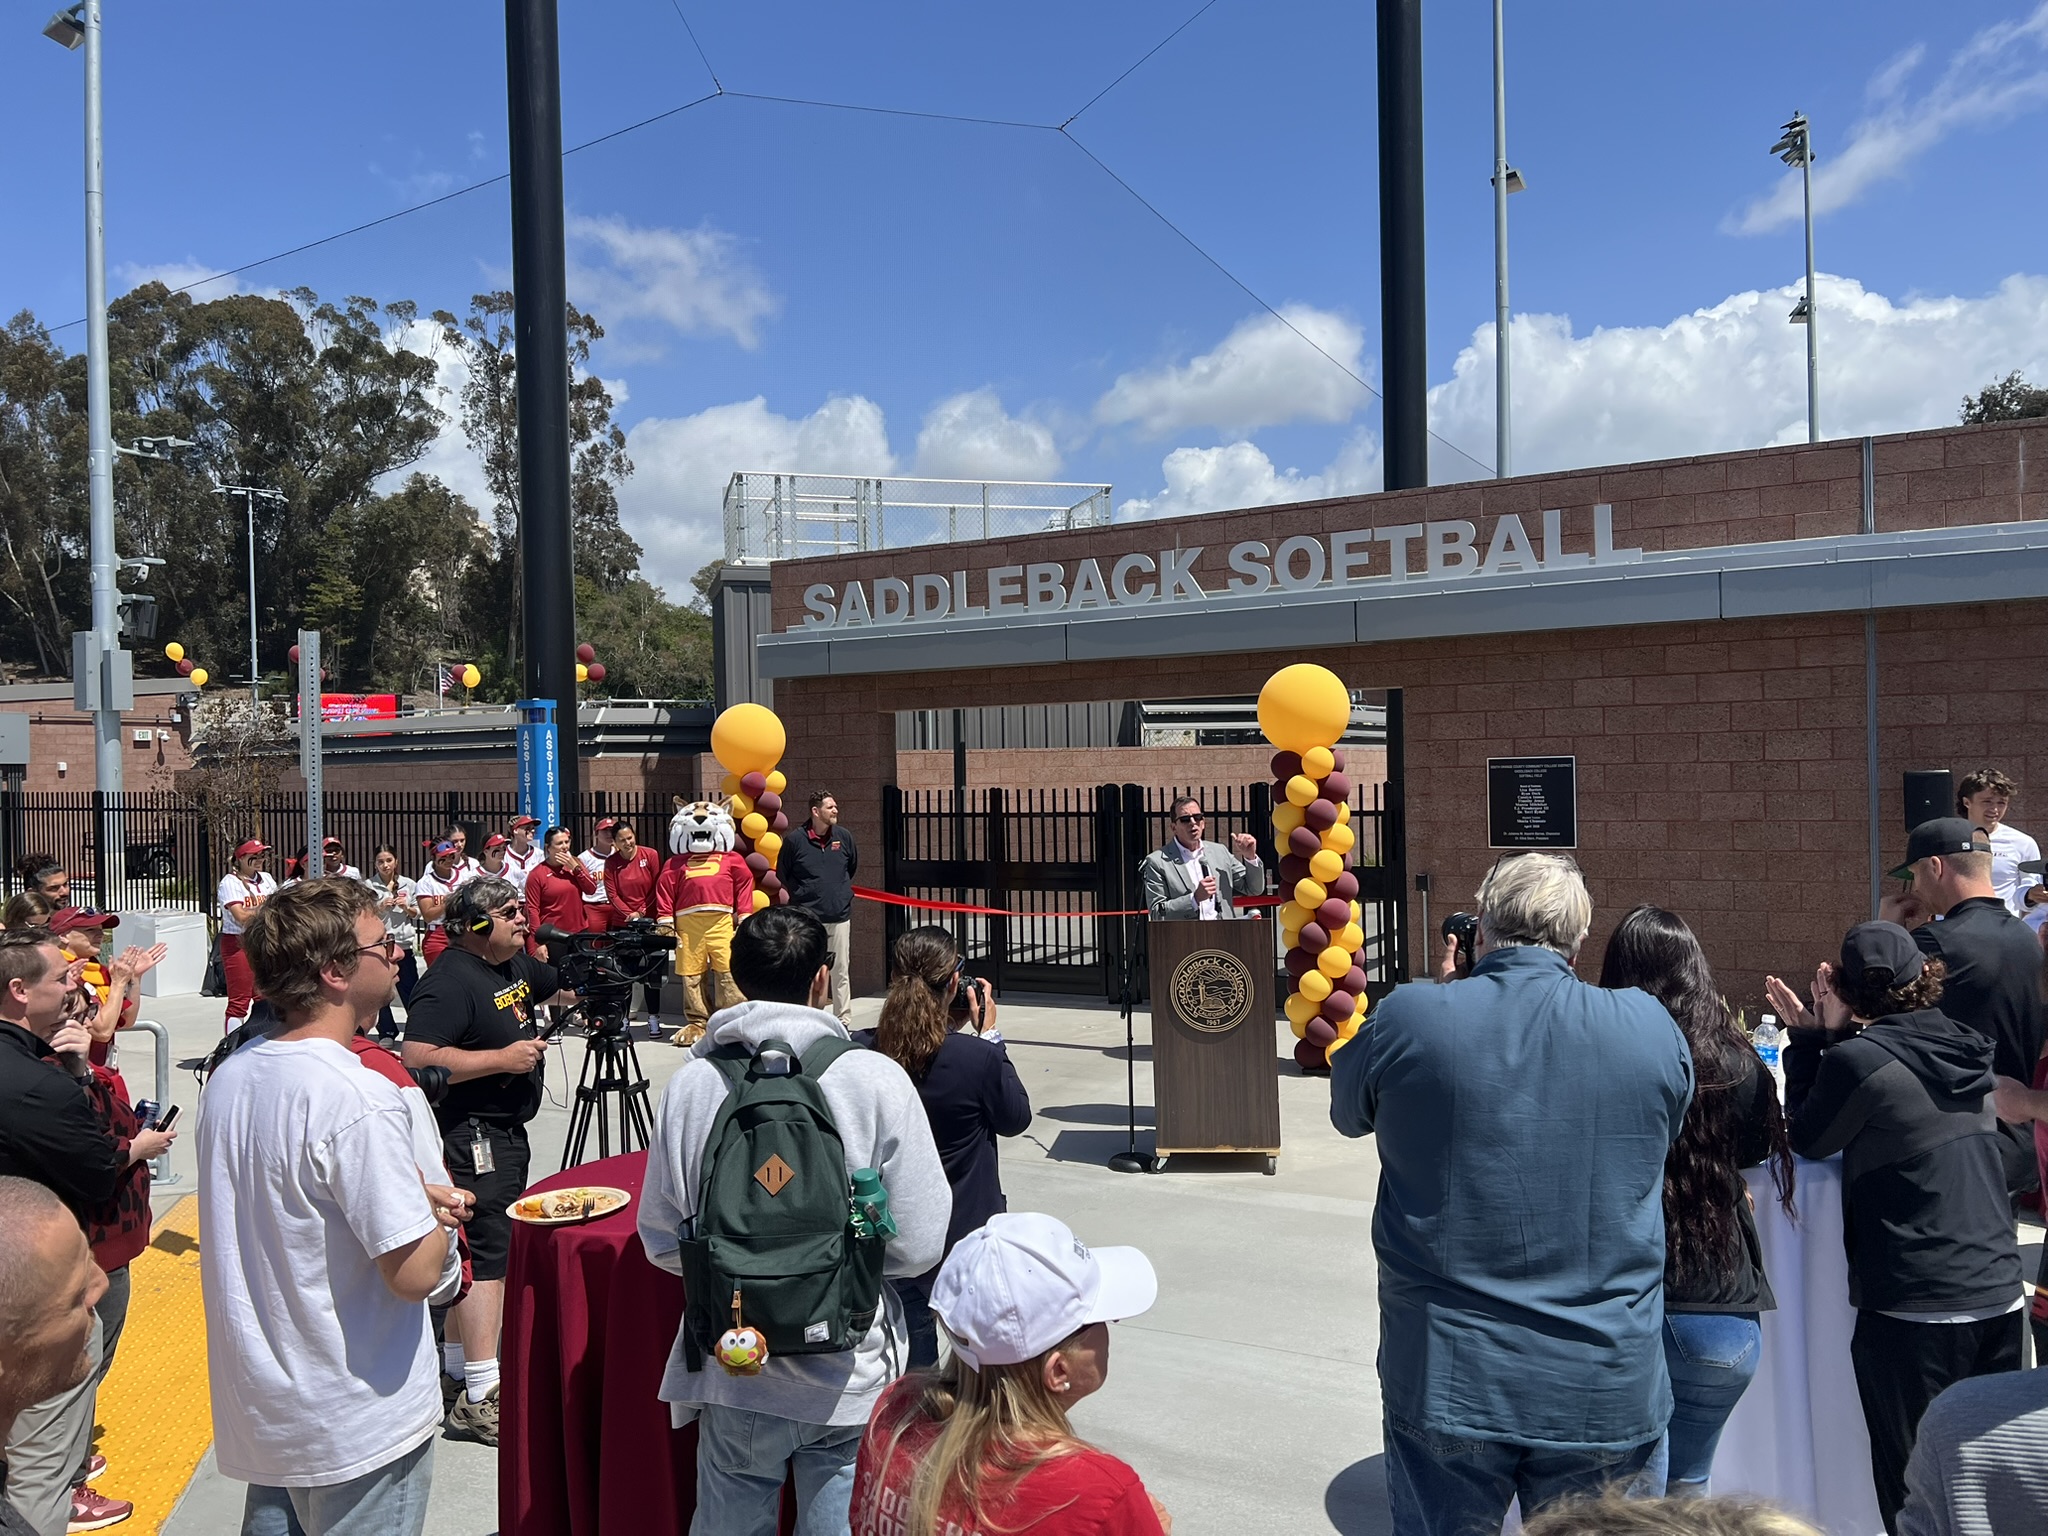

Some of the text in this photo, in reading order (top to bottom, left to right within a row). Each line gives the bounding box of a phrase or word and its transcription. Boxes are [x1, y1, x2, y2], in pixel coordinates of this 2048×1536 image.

[803, 504, 1643, 630] SADDLEBACK SOFTBALL
[523, 730, 532, 818] ASSISTAN
[545, 729, 555, 828] ASSISTANC
